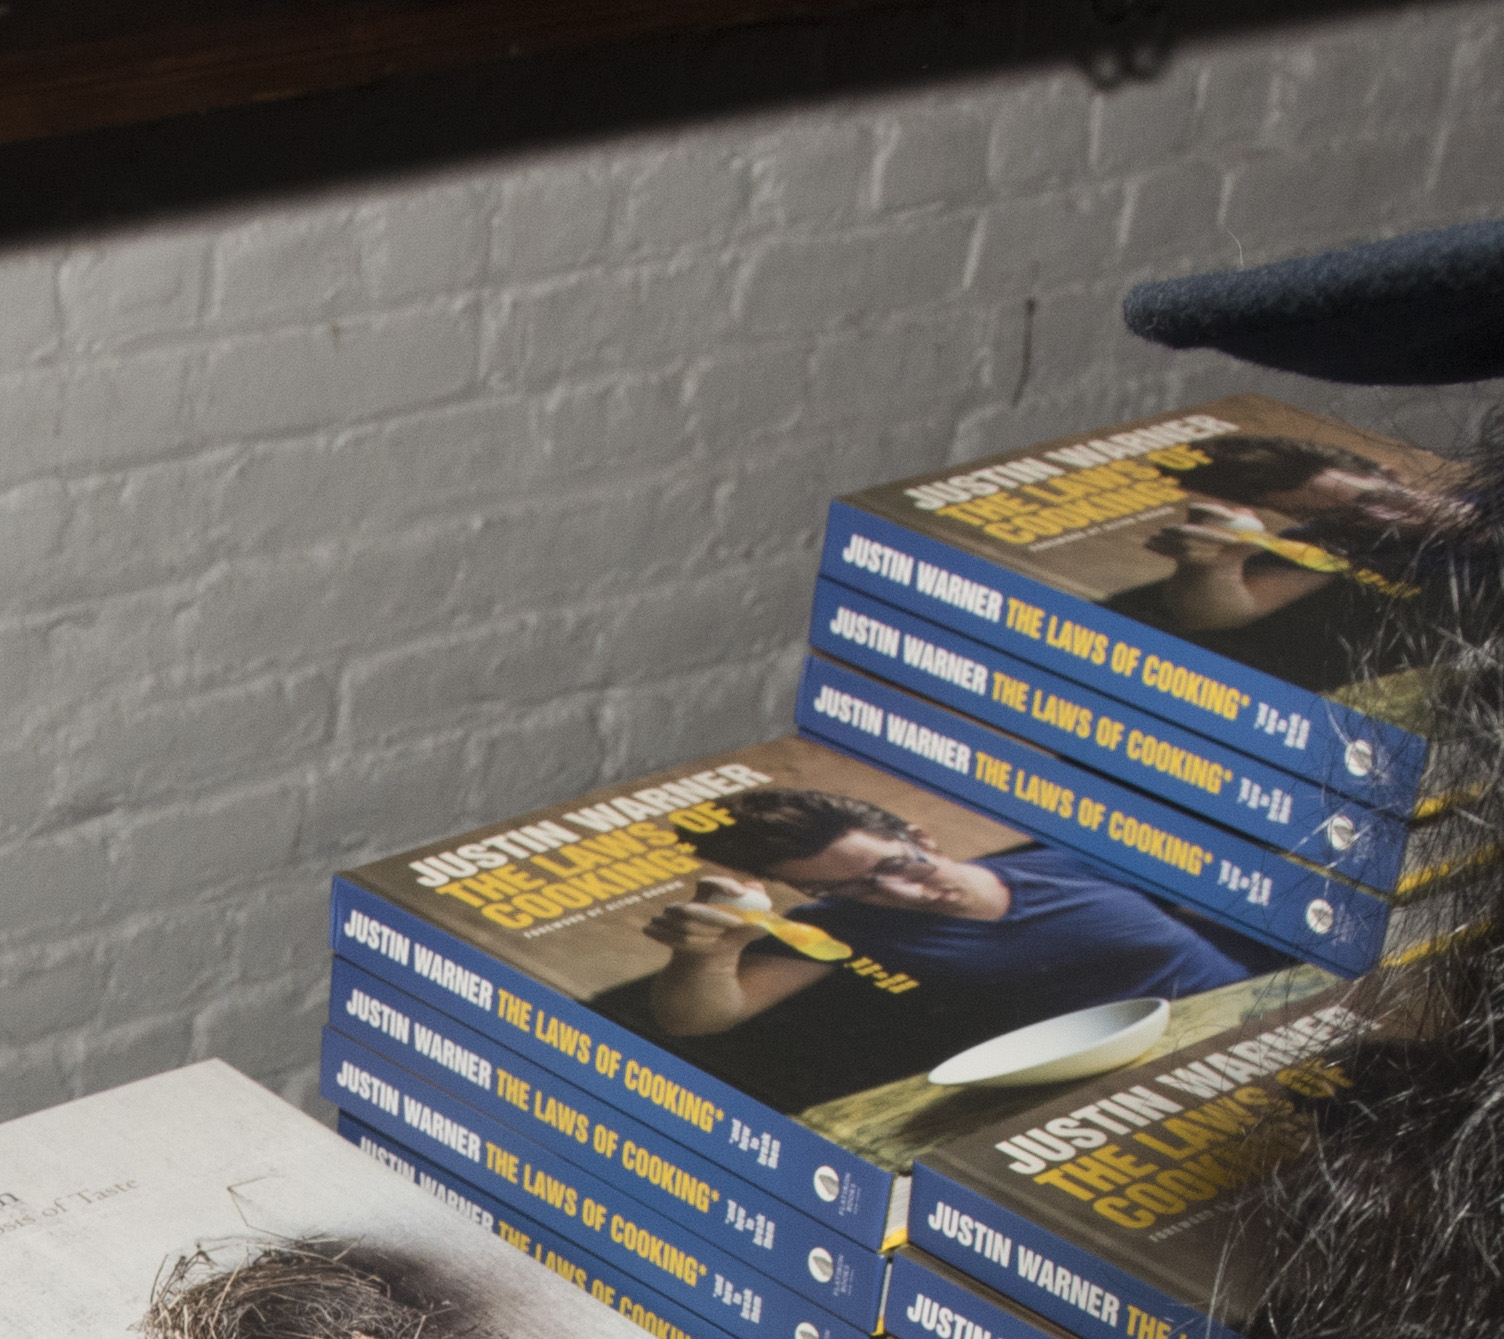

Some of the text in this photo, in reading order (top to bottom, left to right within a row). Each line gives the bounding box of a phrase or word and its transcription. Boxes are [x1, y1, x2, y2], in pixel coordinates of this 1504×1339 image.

[842, 533, 913, 586] JUSTIN
[917, 558, 1001, 624] WARNER
[1004, 599, 1042, 638] THE
[1046, 612, 1106, 662] LAWS
[1111, 642, 1139, 677] OF
[344, 909, 410, 966] JUSTIN
[414, 943, 493, 1011] WARNER
[496, 988, 533, 1027] THE
[537, 1001, 593, 1061] LAWS
[597, 1041, 623, 1072] OF
[40, 1196, 68, 1222] of
[74, 1177, 140, 1207] Taste
[927, 1201, 1011, 1263] JUSTIN
[1017, 1250, 1120, 1327] WARNER
